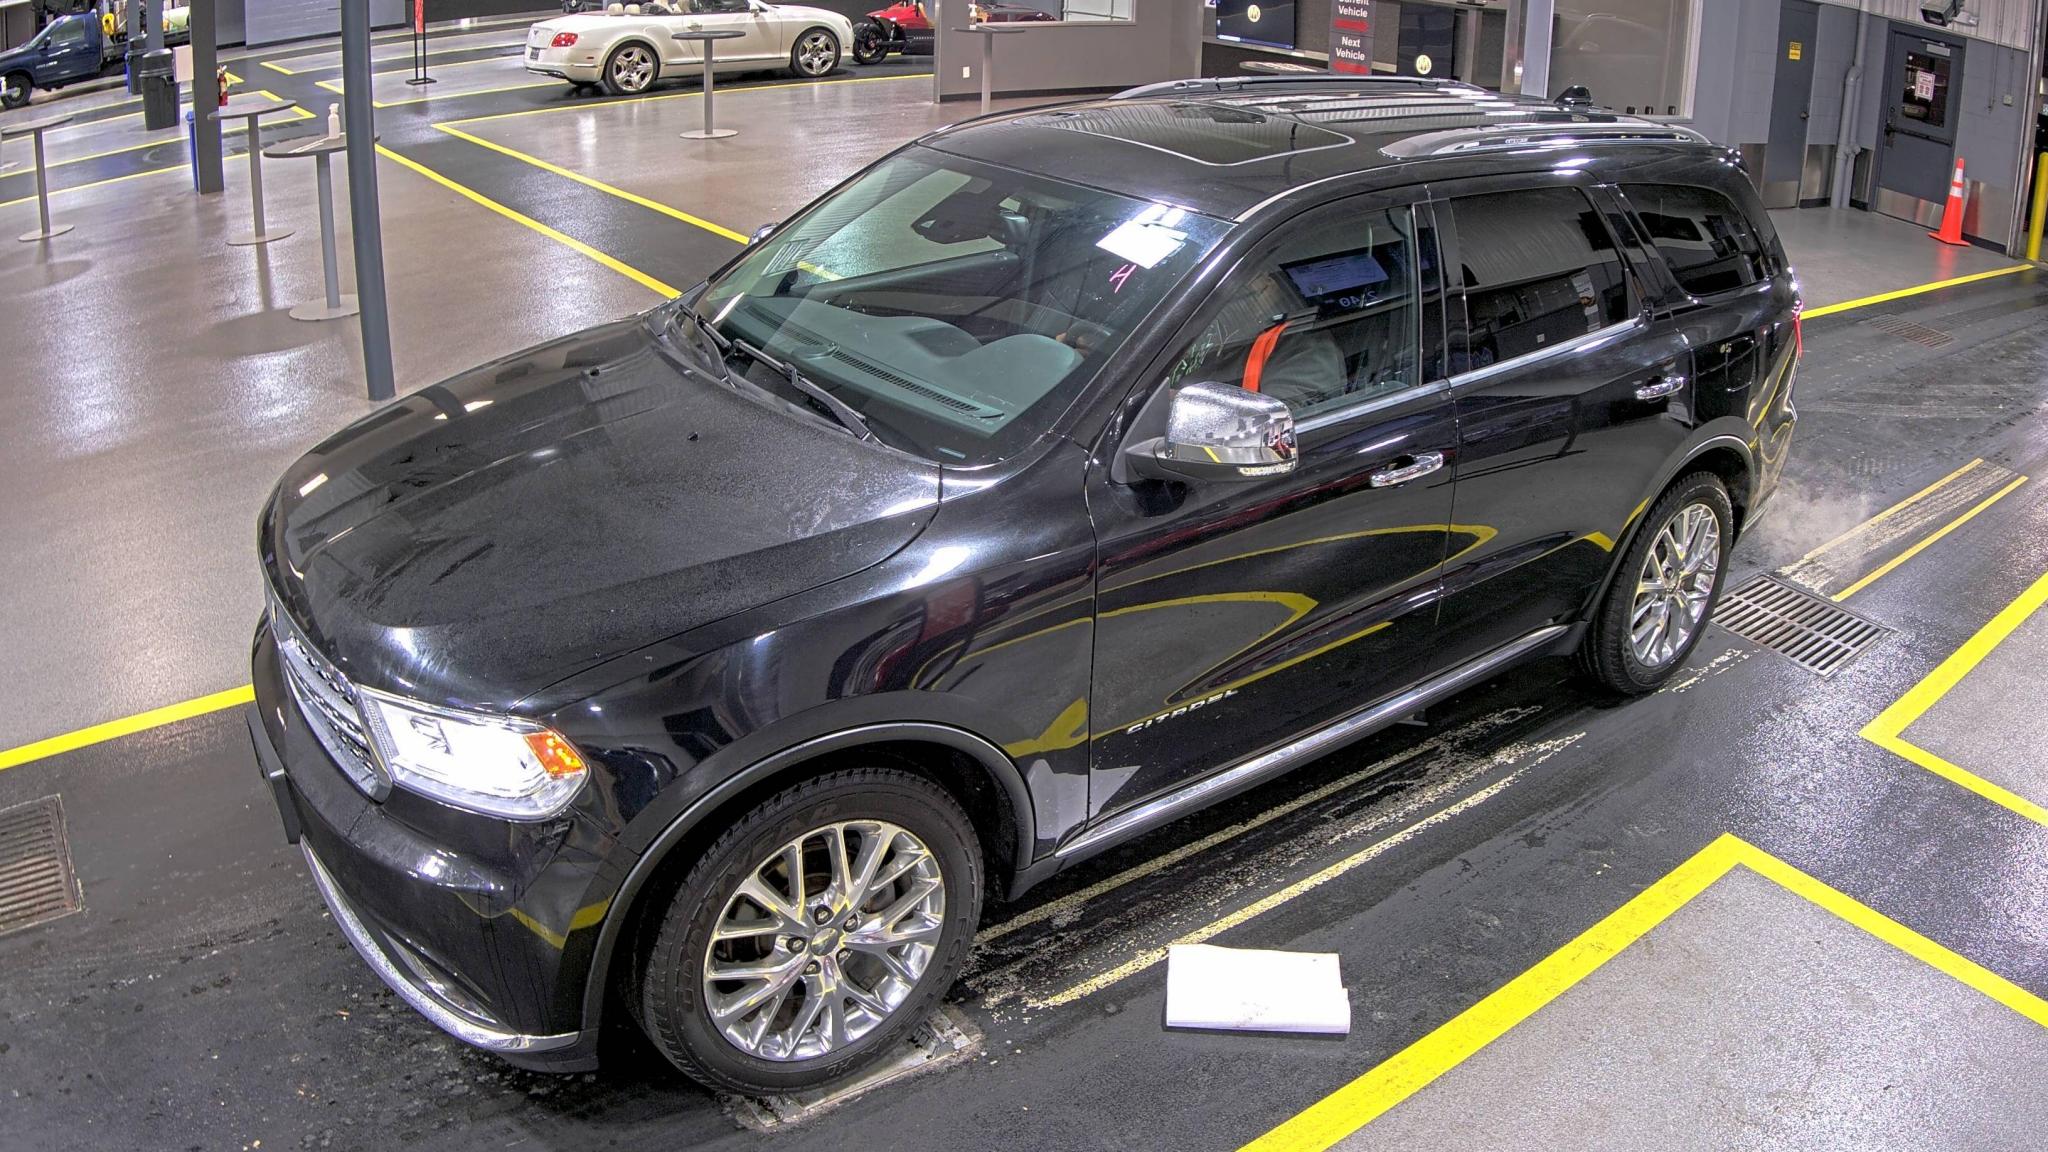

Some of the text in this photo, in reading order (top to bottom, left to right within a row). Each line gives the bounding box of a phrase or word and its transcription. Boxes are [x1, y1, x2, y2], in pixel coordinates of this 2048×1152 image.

[1338, 5, 1368, 17] Vehicle
[1341, 36, 1361, 48] Next
[1335, 47, 1366, 61] Vehicle
[1126, 690, 1239, 734] CITADEL
